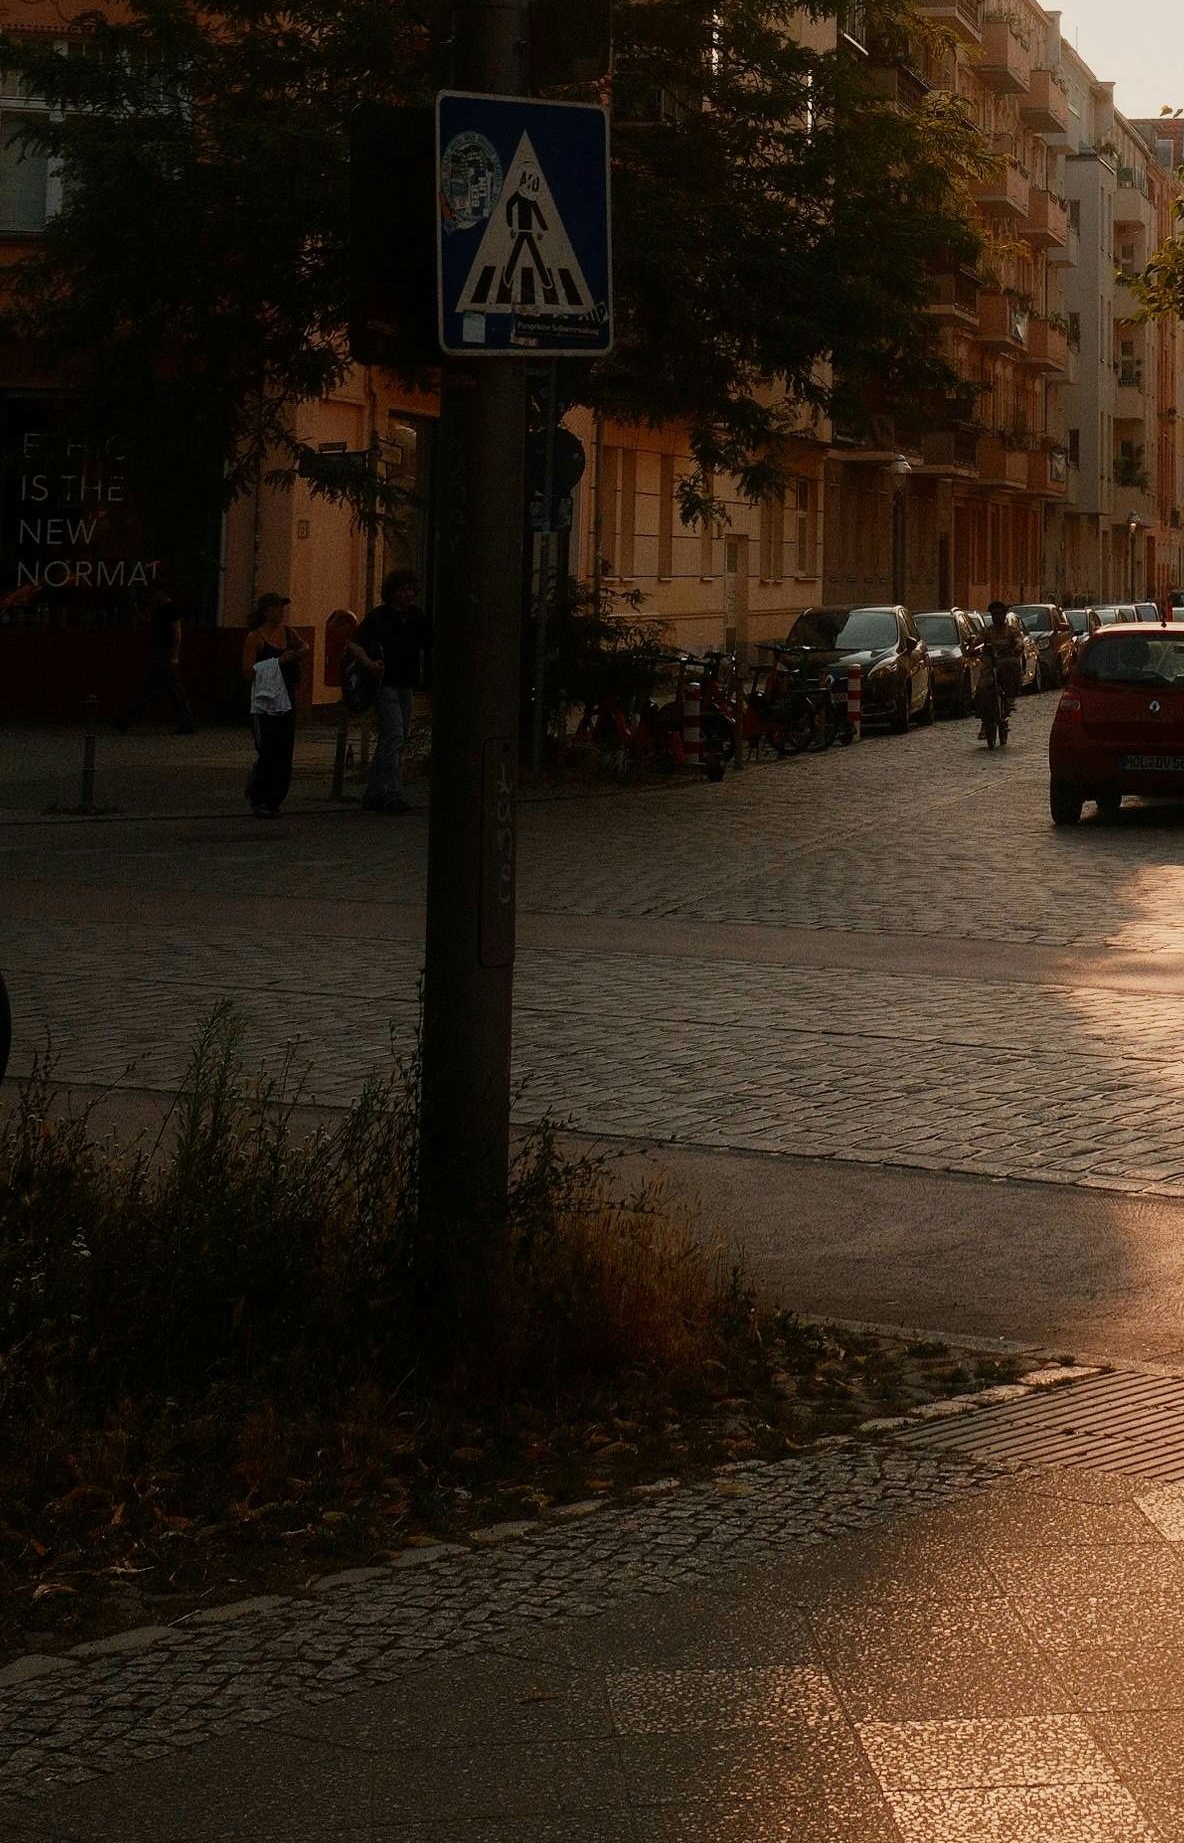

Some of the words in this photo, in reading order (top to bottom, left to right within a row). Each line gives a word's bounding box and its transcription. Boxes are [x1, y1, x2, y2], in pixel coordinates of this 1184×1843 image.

[21, 474, 49, 501] IS
[60, 474, 125, 502] THE
[18, 518, 97, 545] NEW
